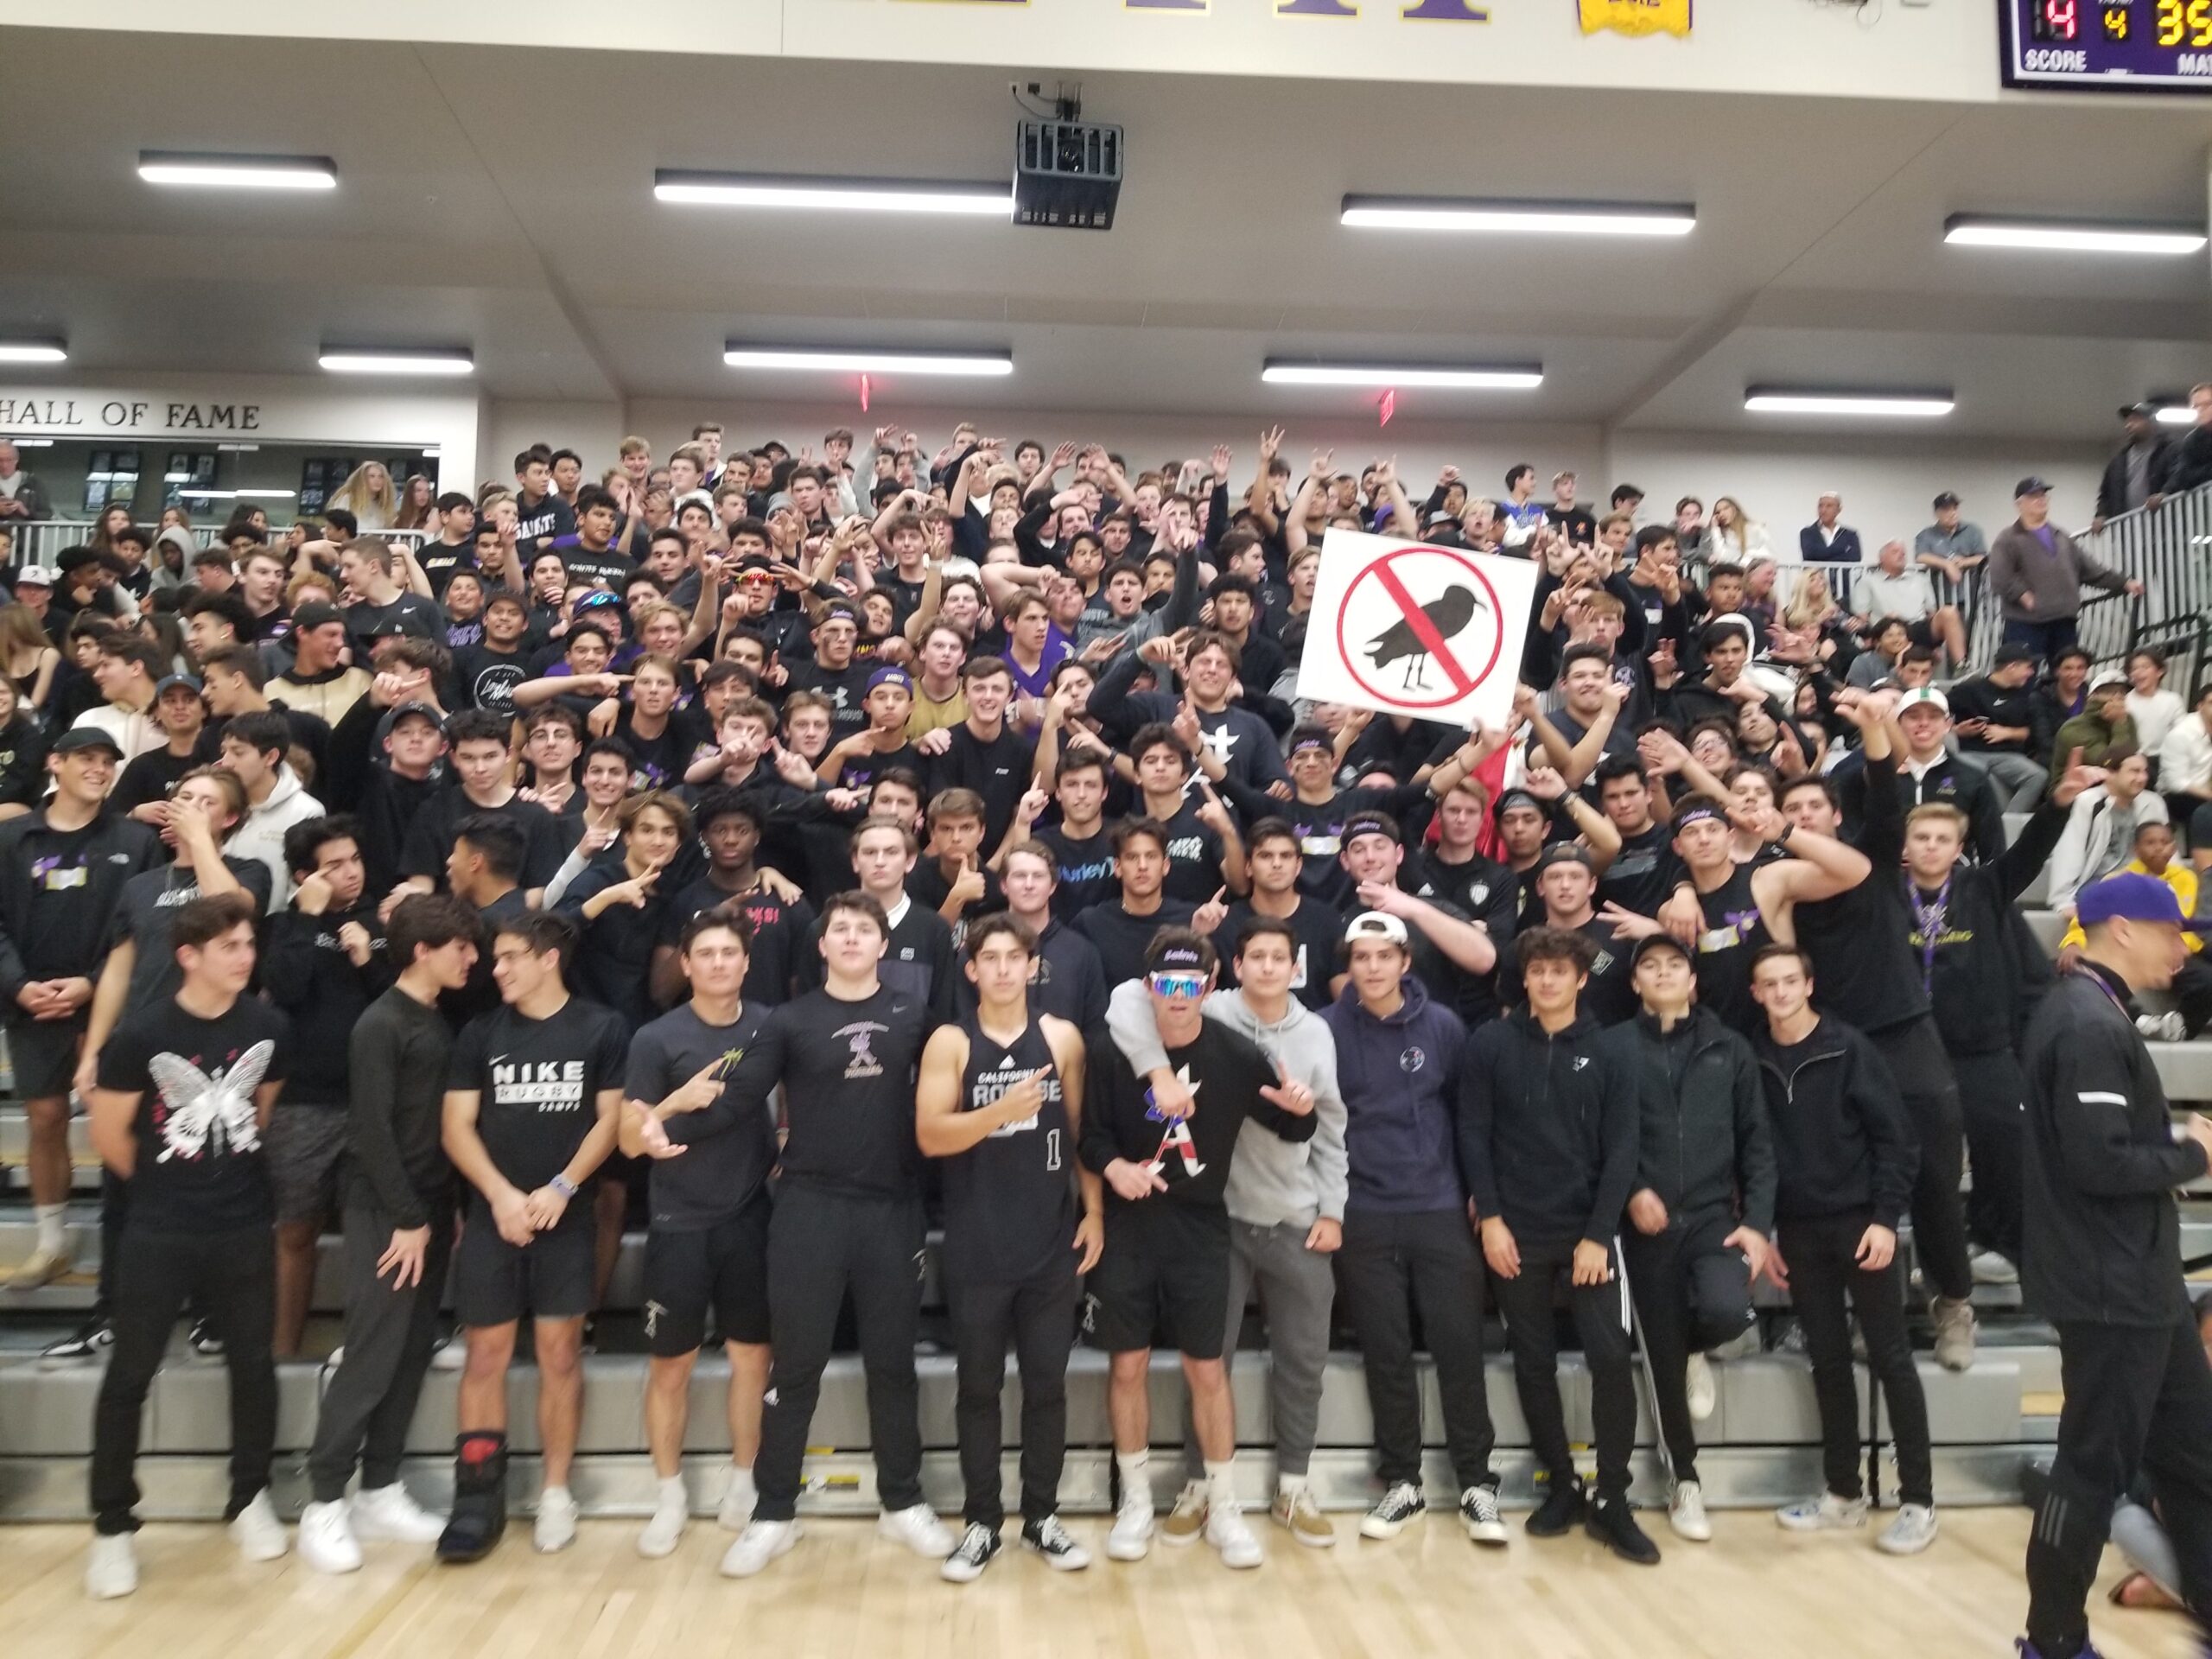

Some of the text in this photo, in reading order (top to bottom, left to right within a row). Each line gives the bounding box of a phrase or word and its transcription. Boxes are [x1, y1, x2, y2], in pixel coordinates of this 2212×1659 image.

[2105, 10, 2127, 39] 4
[2024, 48, 2088, 71] SCORE
[0, 399, 259, 429] HALL OF FAME
[493, 1060, 585, 1085] NIKE
[977, 1068, 1043, 1084] CALIFORNI
[1046, 1128, 1061, 1171] 1
